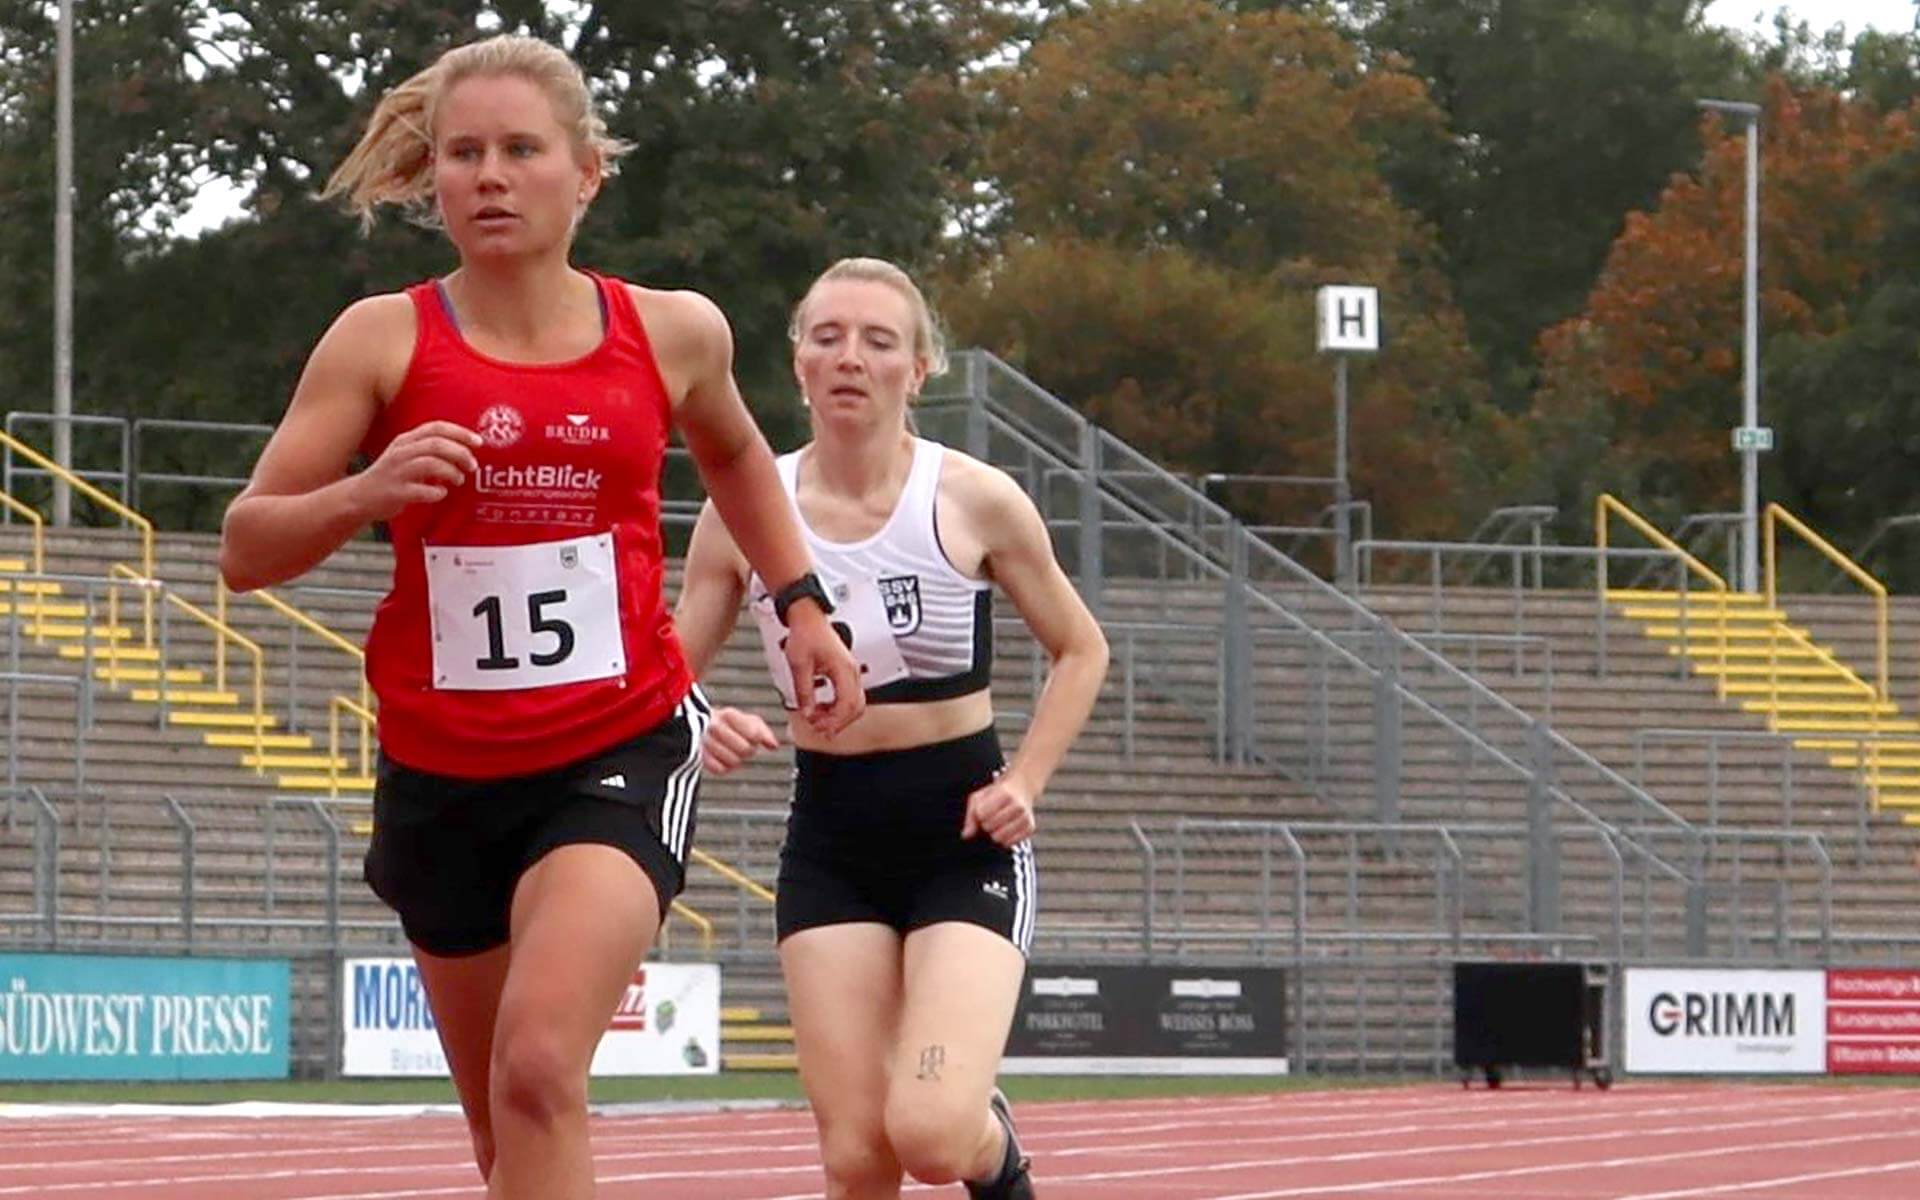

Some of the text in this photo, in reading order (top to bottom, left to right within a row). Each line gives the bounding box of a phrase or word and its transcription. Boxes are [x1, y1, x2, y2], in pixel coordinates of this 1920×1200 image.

[1338, 297, 1366, 338] H
[545, 424, 610, 441] BRUDER
[475, 464, 602, 493] LichtBlick
[472, 588, 576, 670] 15
[150, 994, 273, 1056] PRESSE
[1648, 992, 1796, 1037] GRIMM
